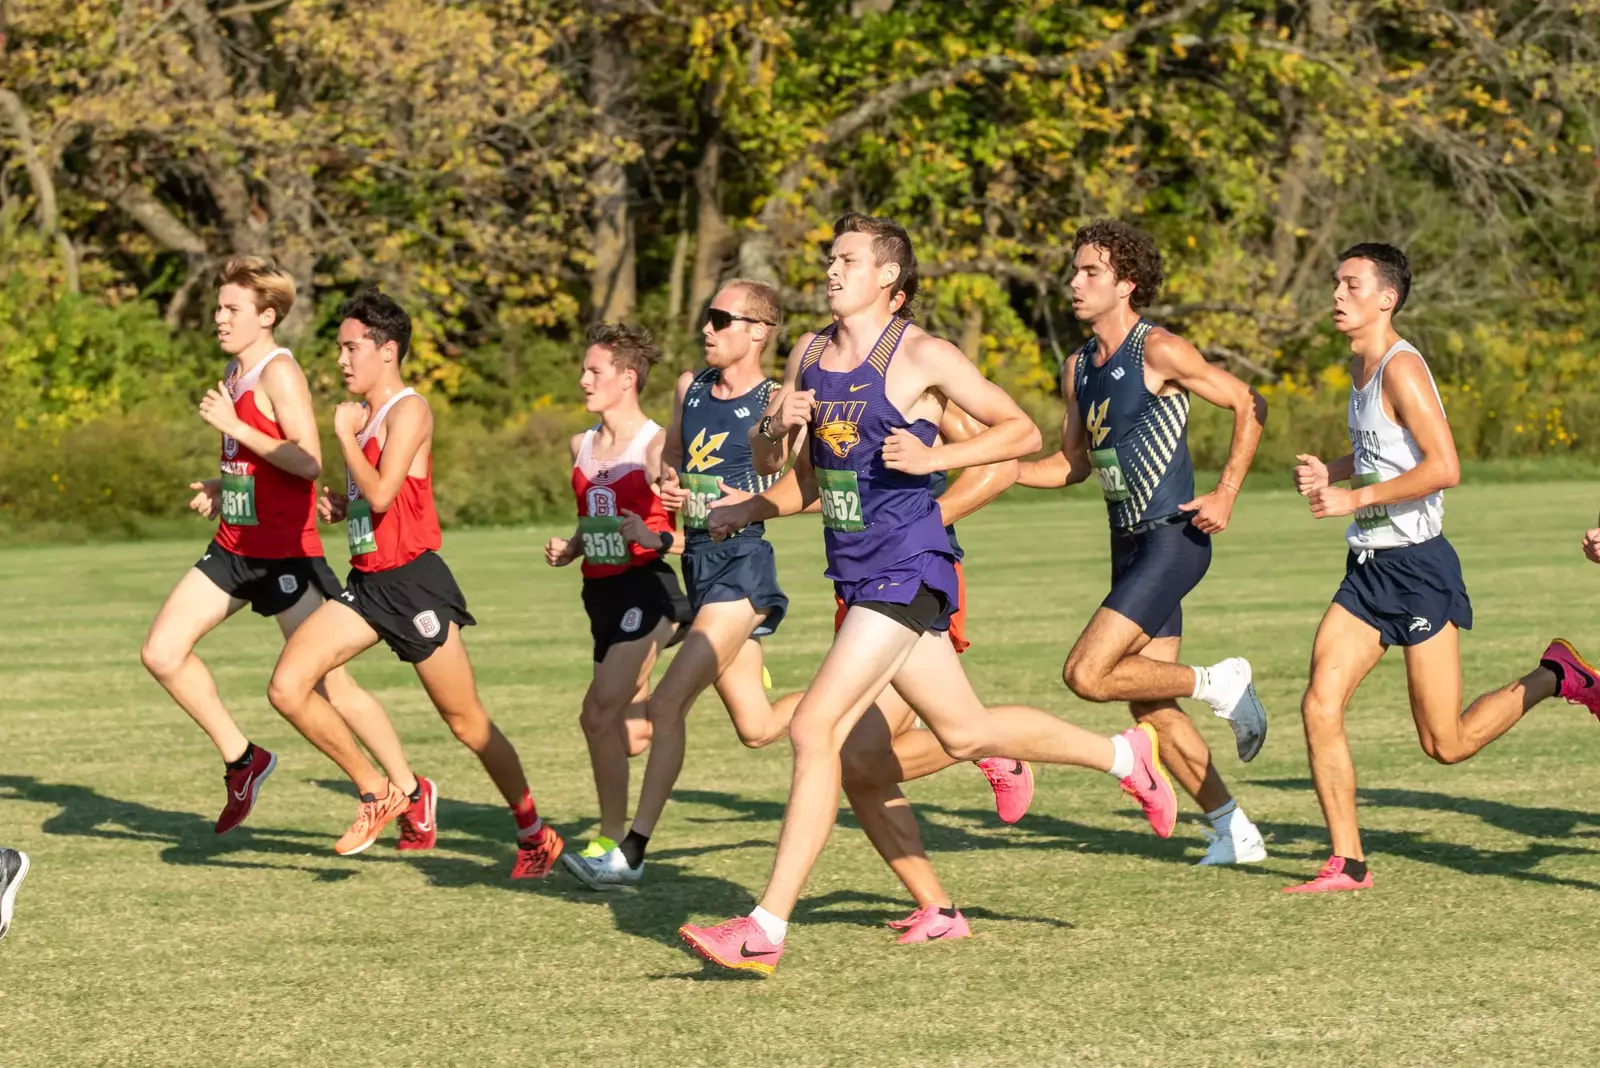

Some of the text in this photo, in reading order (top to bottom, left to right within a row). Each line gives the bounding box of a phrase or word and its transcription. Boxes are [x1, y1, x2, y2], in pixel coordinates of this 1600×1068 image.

[222, 489, 251, 517] 3511
[593, 492, 609, 516] B
[818, 486, 861, 521] 3652
[582, 532, 626, 558] 3513
